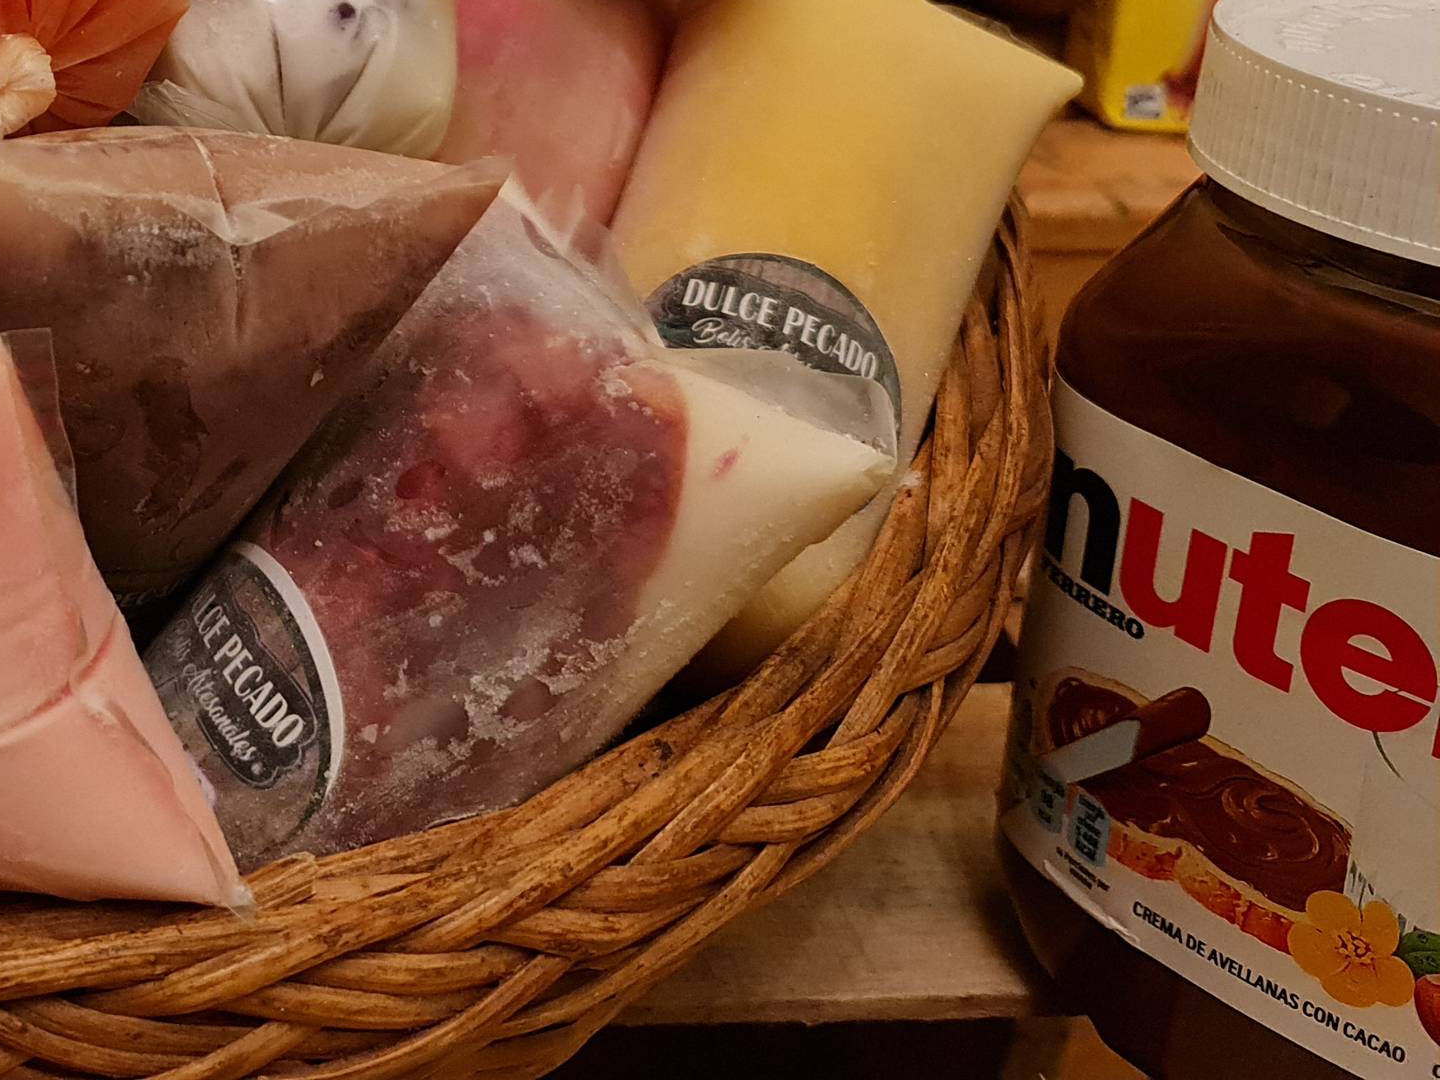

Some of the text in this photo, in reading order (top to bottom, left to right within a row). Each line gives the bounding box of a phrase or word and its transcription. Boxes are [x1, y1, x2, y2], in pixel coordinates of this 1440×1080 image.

[681, 277, 878, 380] DULCE PECADO
[191, 586, 305, 748] ULCE PECADO
[1044, 446, 1440, 762] nute
[182, 662, 257, 762] Artesanales
[1132, 901, 1406, 1063] CREMA DE AVELLANAS CON CACAO
